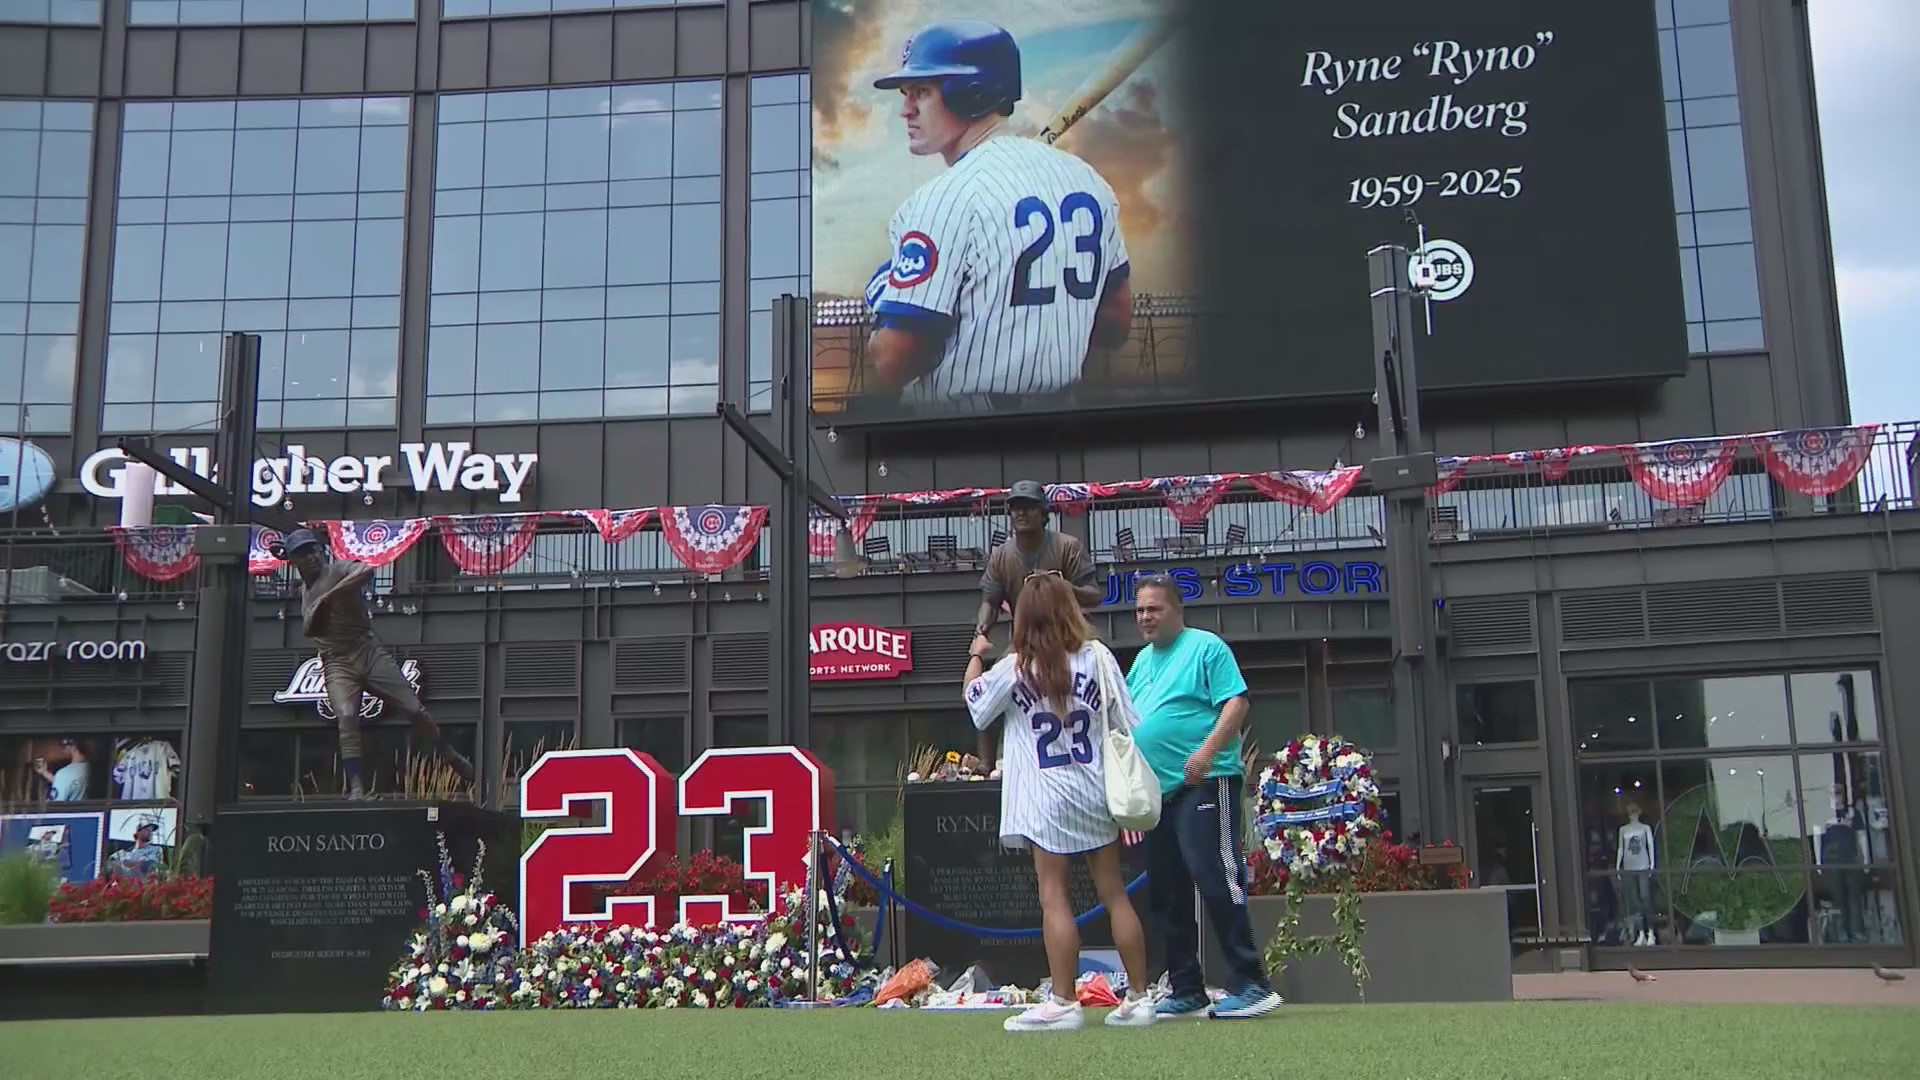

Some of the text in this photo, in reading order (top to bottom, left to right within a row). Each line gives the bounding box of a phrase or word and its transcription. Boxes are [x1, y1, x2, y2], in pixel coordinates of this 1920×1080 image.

[1300, 31, 1554, 95] Ryne “Ryno”
[1333, 94, 1529, 139] Sandberg
[1010, 191, 1103, 307] 23
[80, 442, 538, 507] Gllgher Way
[1224, 561, 1388, 597] STOR
[66, 640, 145, 660] room
[810, 627, 908, 659] ARQUEE
[810, 663, 891, 676] ORTS NETWORK
[1031, 709, 1093, 770] 23
[267, 833, 385, 852] RON SANTO
[936, 815, 996, 833] RYNE
[520, 745, 822, 950] 23
